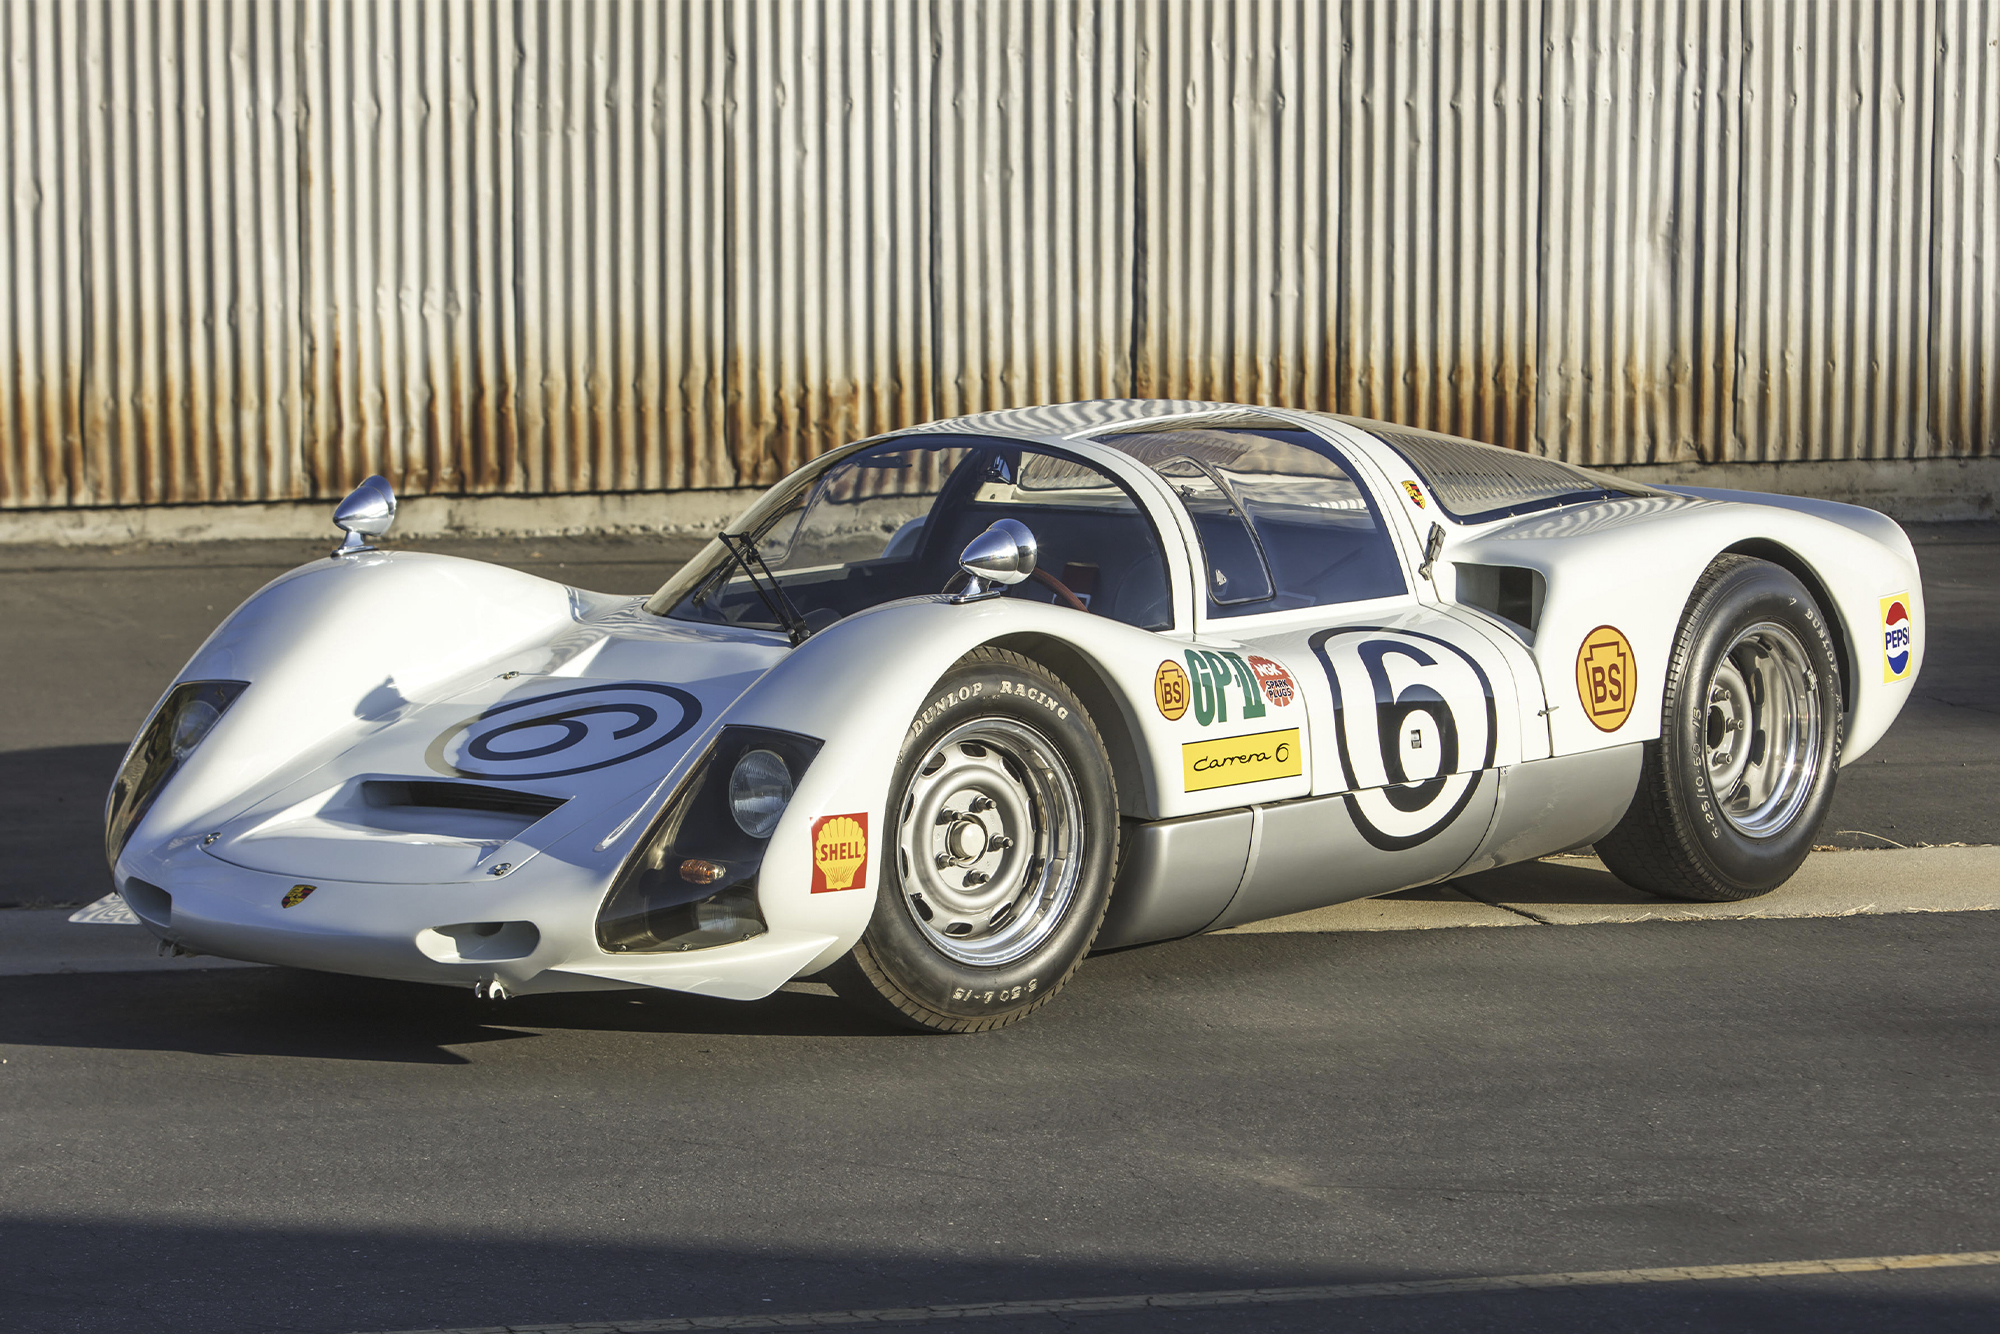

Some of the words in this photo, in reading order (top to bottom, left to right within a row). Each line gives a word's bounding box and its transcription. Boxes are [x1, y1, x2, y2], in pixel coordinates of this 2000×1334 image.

[1884, 626, 1910, 650] PEPSI
[1254, 663, 1282, 677] NGK
[1163, 681, 1182, 705] BS
[1265, 679, 1289, 690] SPARK
[1268, 687, 1292, 699] PLUGS
[1591, 663, 1623, 704] BS
[911, 682, 984, 738] DUNLOP
[1000, 680, 1069, 720] RACING
[467, 703, 657, 761] 6
[1357, 640, 1459, 813] 6
[1193, 752, 1272, 772] Carrera
[1275, 742, 1291, 763] 6
[820, 841, 862, 862] SHELL
